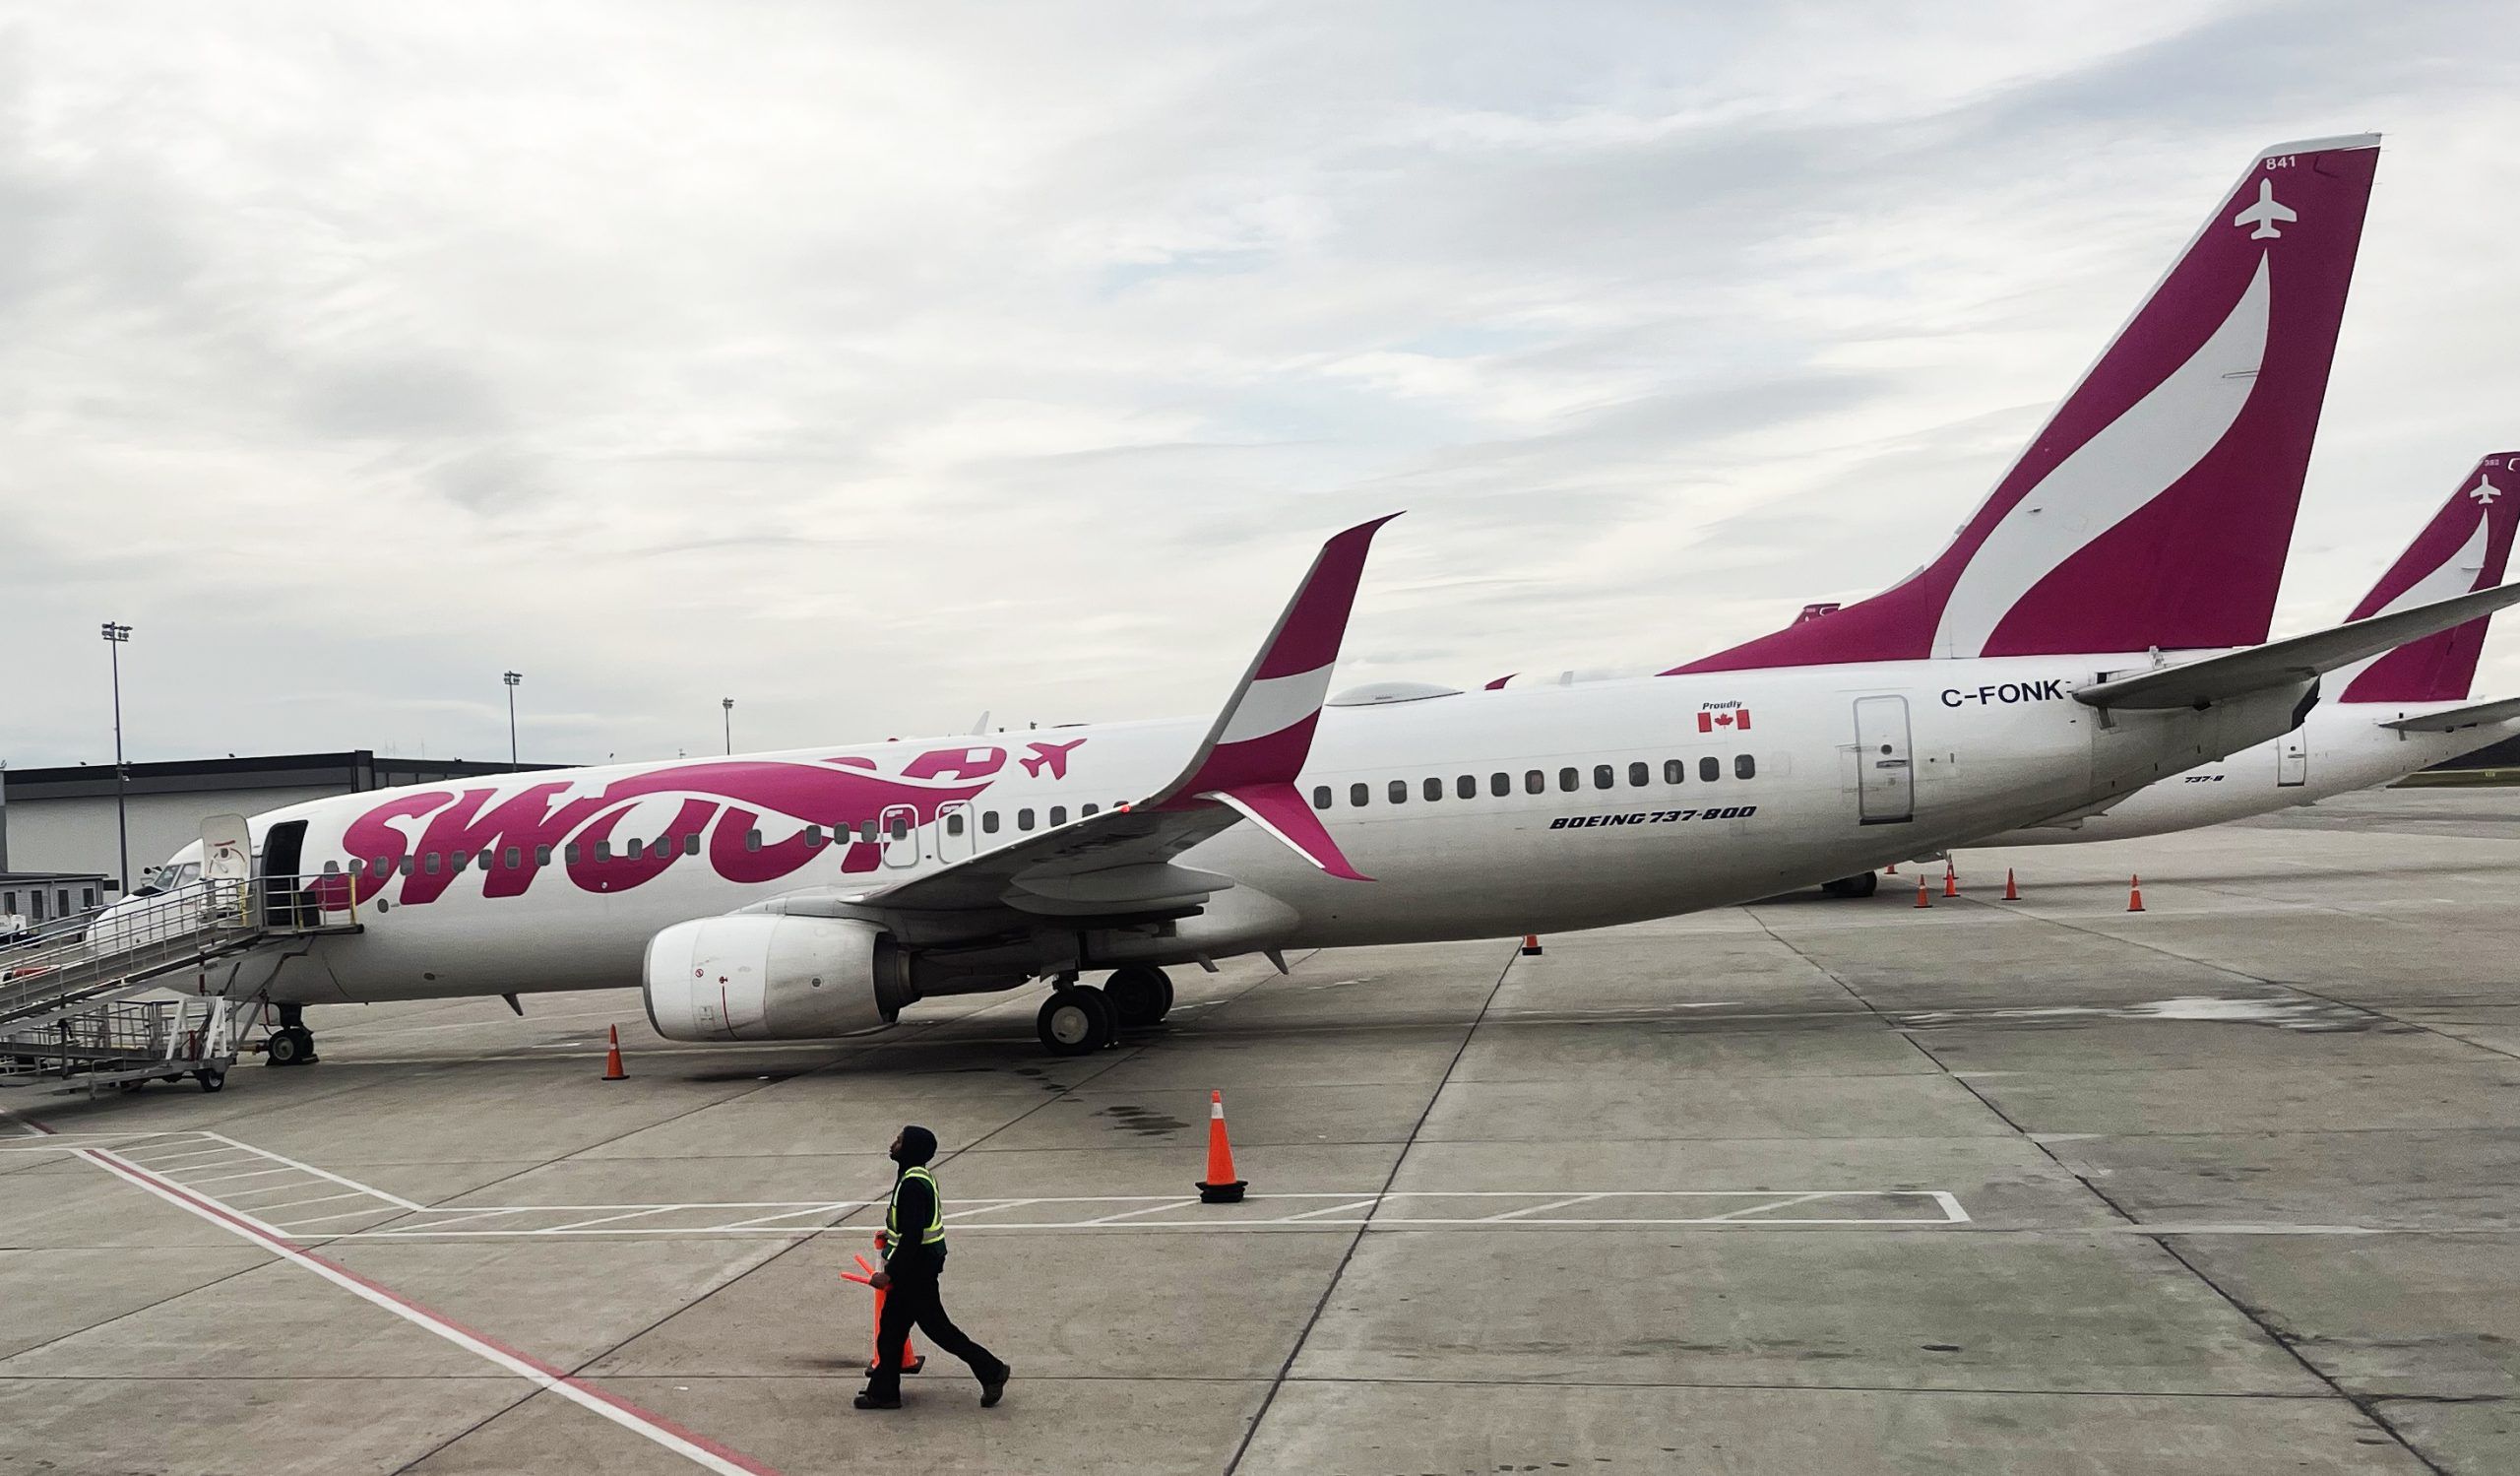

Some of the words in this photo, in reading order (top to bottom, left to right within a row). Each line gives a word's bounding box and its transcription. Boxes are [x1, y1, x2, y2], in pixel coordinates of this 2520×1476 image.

[2266, 156, 2296, 170] 841
[1941, 679, 2063, 707] C-FONK
[1702, 700, 1742, 710] Proudly
[1549, 813, 1646, 829] BOEING
[1649, 805, 1757, 823] 737-800
